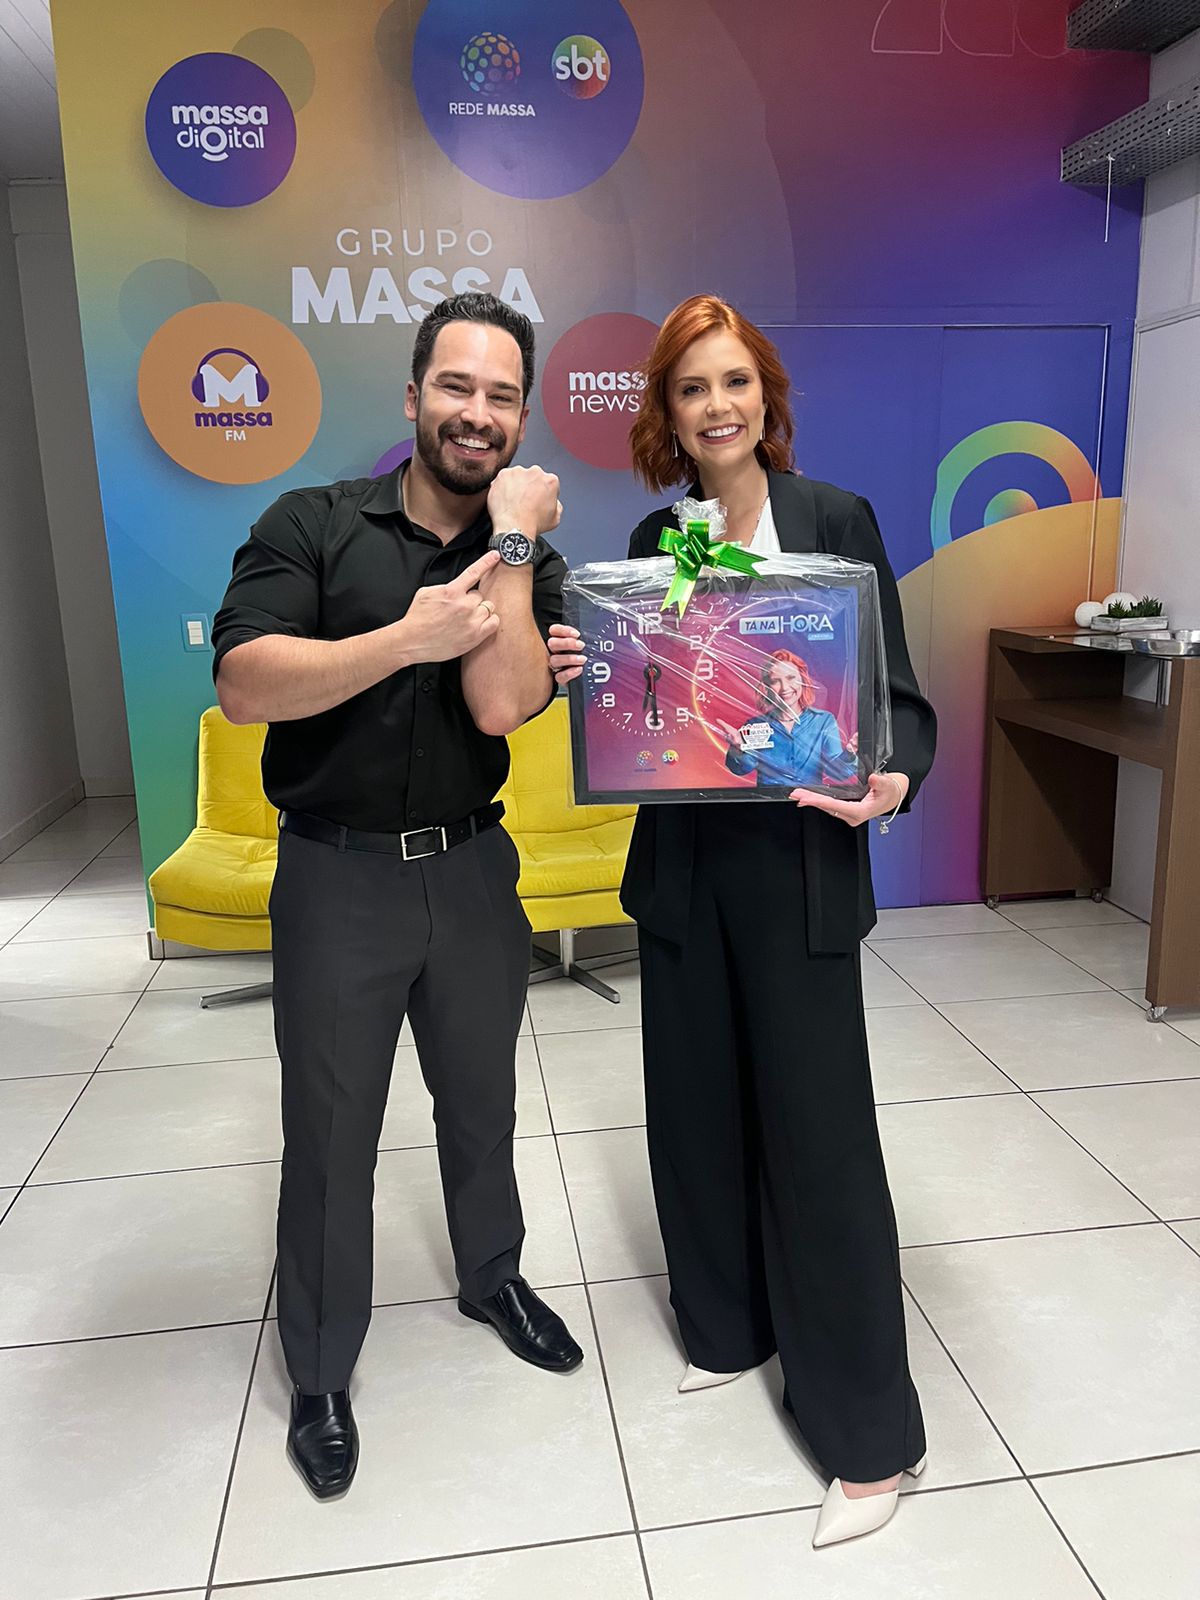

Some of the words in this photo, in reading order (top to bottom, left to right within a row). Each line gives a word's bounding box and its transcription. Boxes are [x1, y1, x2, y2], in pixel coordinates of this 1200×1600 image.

[555, 44, 607, 81] sbt
[172, 104, 269, 125] massa
[449, 102, 484, 116] REDE
[486, 103, 536, 117] MASSA
[336, 228, 493, 256] GRUPO
[569, 371, 649, 391] mass
[569, 394, 641, 413] news
[194, 411, 273, 427] massa
[225, 429, 247, 441] FM
[617, 621, 628, 636] 11
[760, 620, 776, 631] NA
[780, 614, 834, 633] HORA
[600, 640, 614, 652] 10
[592, 662, 612, 683] 9
[697, 659, 714, 680] 3
[602, 693, 615, 707] 8
[696, 691, 707, 702] 4
[623, 713, 633, 724] 7
[645, 710, 665, 731] 6
[676, 707, 690, 722] 5
